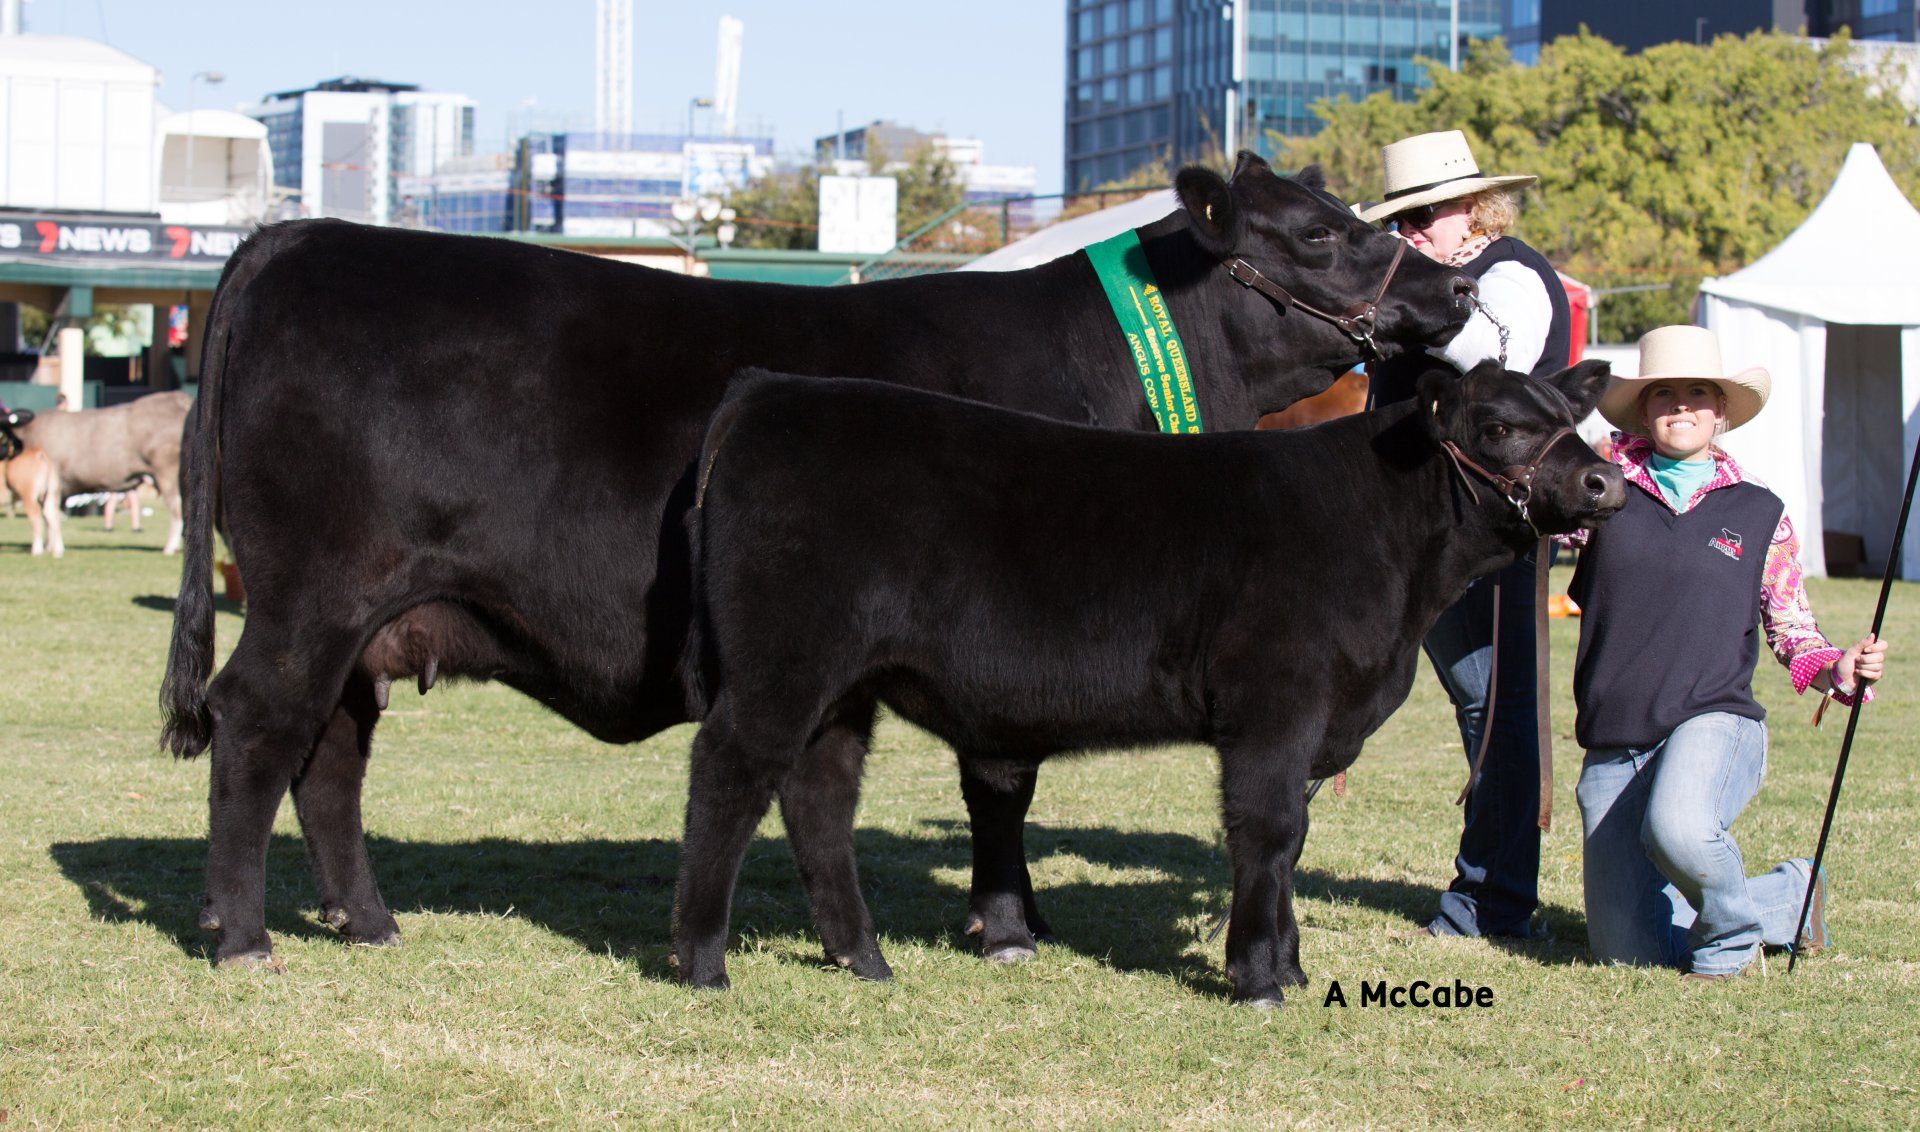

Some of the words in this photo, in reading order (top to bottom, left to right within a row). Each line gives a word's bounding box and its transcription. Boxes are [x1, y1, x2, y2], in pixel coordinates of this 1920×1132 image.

[0, 222, 22, 249] S
[1127, 332, 1151, 376] ANGUS
[1144, 377, 1159, 408] COW
[1144, 326, 1166, 373] Reserve
[1160, 373, 1175, 412] Senior
[1148, 294, 1173, 338] ROYAL
[1166, 339, 1197, 422] QUEENSLAND
[1188, 425, 1200, 434] S
